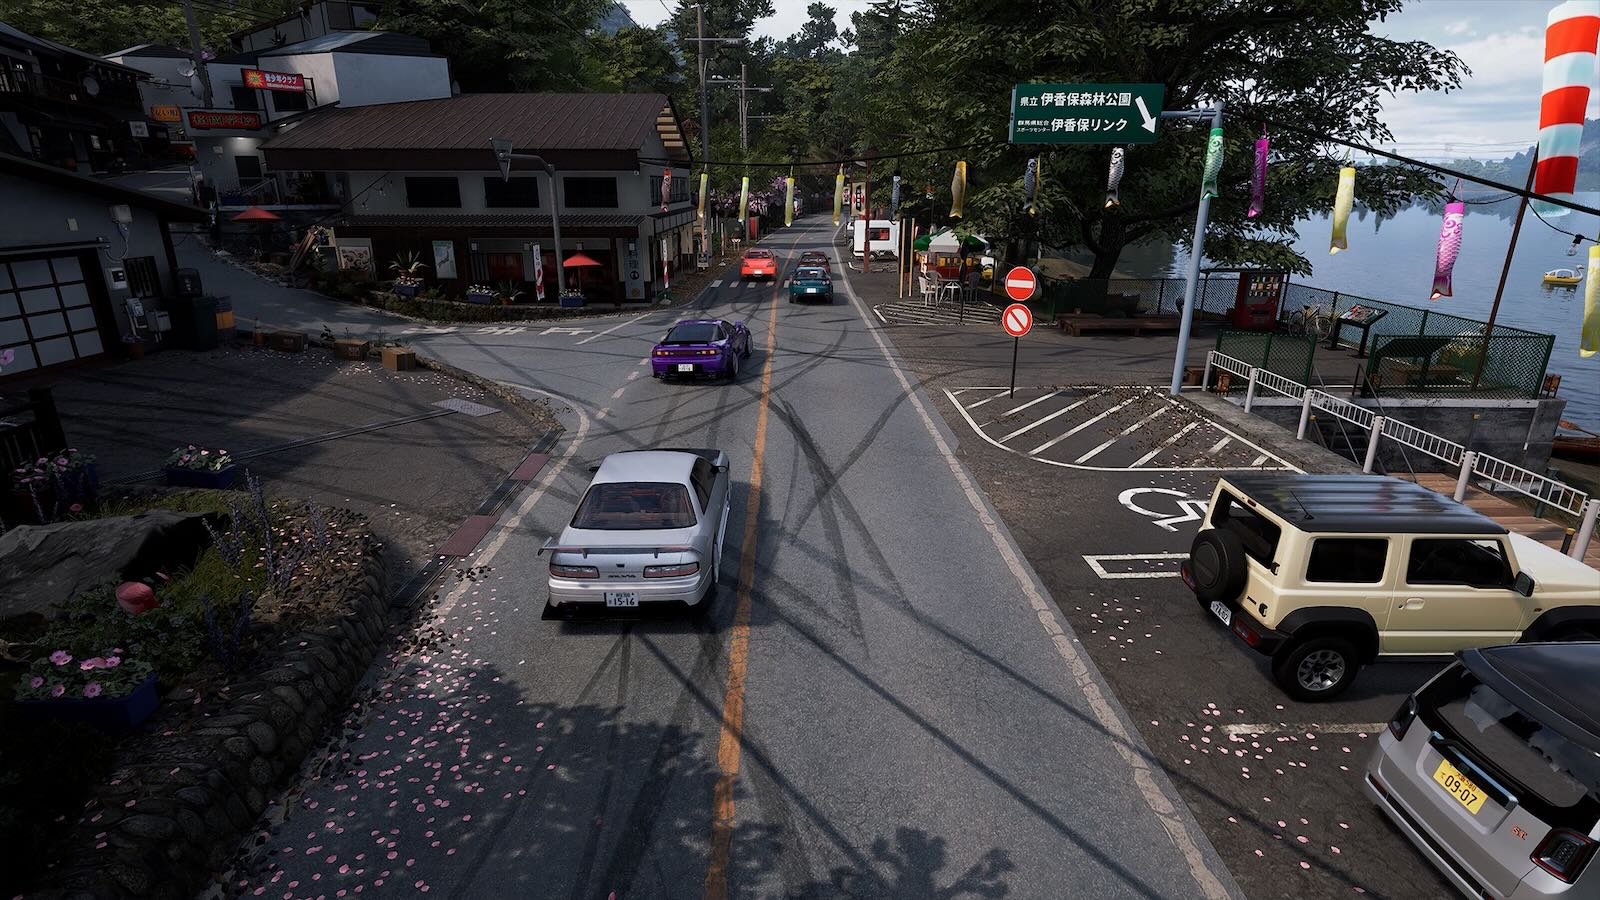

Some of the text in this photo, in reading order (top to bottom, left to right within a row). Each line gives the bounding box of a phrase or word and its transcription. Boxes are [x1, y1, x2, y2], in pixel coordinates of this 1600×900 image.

[1020, 92, 1132, 106] 県立 伊香保森林公園
[1051, 118, 1128, 132] 伊香保リンク
[1444, 775, 1478, 806] 09-07
